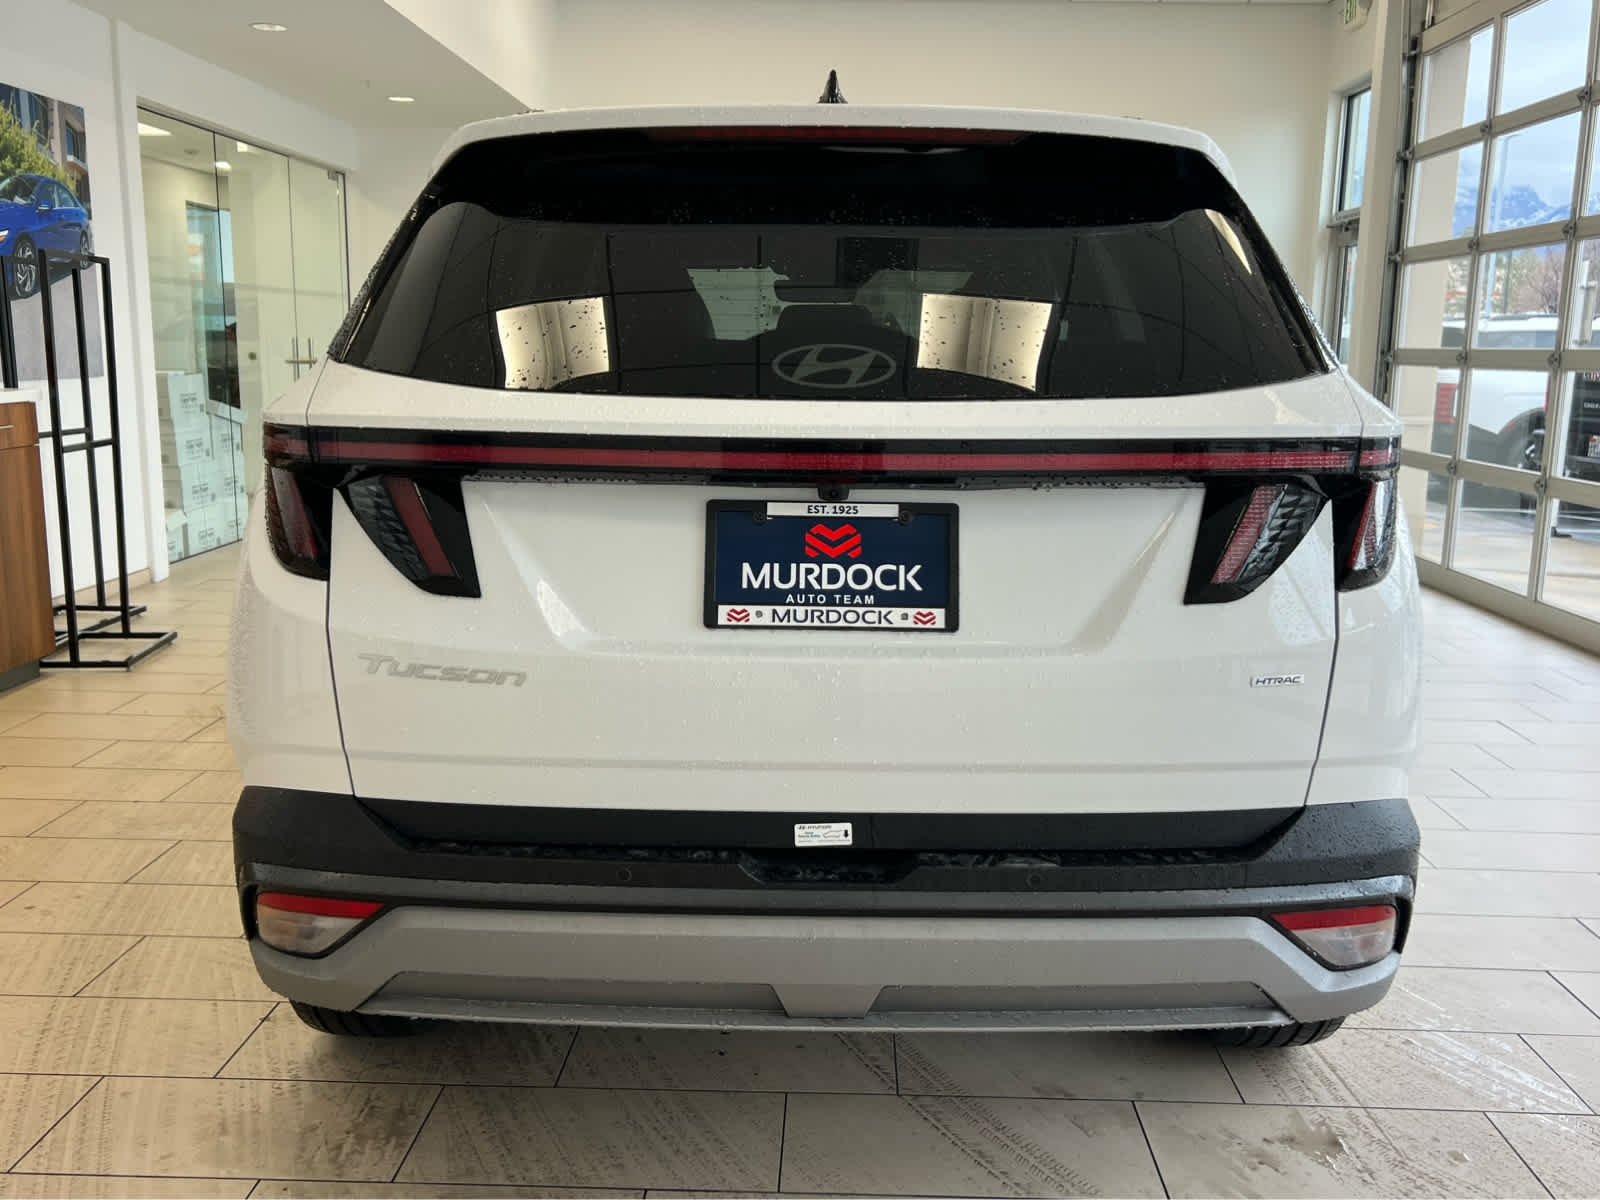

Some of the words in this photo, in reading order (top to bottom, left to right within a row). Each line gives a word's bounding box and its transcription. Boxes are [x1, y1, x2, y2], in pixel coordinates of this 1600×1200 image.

[807, 504, 830, 515] EST.
[832, 505, 859, 515] 1925
[741, 562, 923, 591] MURDOCK
[786, 594, 826, 604] AUTO
[834, 595, 875, 605] TEAM
[771, 608, 893, 625] MURDOCK
[1255, 676, 1301, 685] HTRAC
